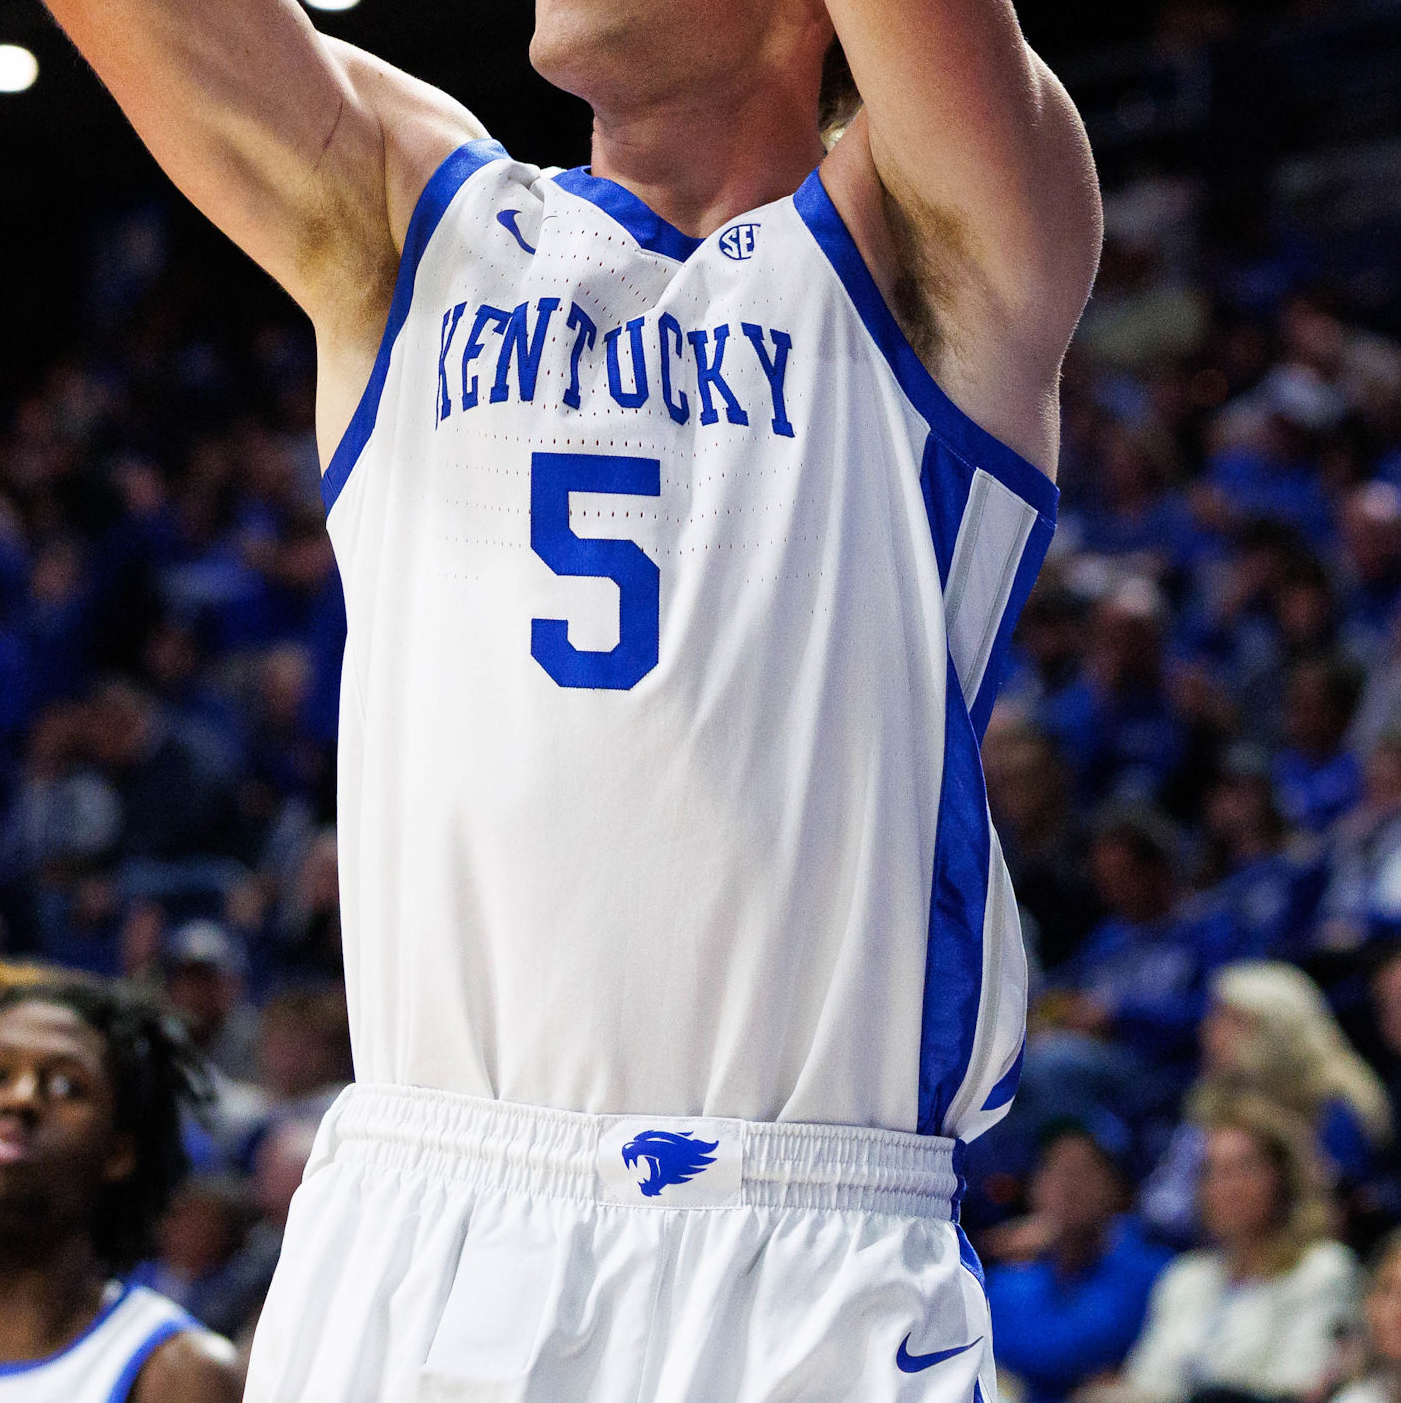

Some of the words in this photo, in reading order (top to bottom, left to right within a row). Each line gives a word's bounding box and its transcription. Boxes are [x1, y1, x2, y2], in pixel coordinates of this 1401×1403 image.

[719, 224, 761, 260] SE
[435, 297, 796, 438] KENTUCKY
[530, 452, 661, 690] 5
